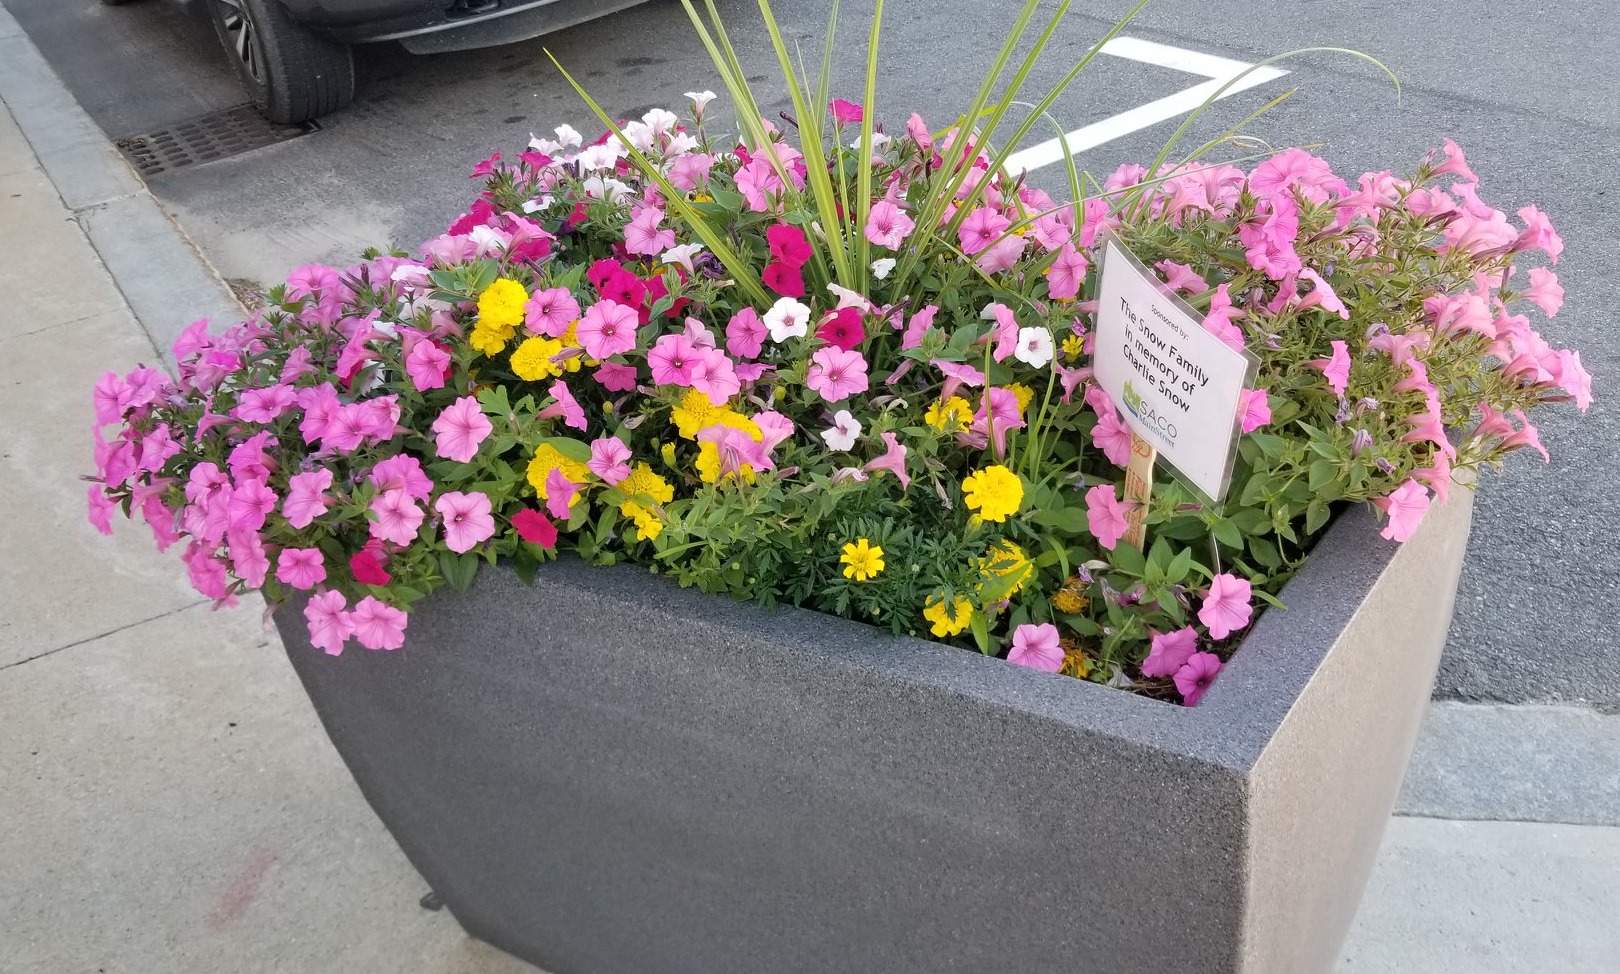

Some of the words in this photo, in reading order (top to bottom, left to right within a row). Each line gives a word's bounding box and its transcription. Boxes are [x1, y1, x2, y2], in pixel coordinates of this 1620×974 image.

[1120, 296, 1137, 324] The
[1138, 318, 1167, 352] Snow
[1168, 345, 1209, 387] Family
[1151, 304, 1179, 333] Sponsored
[1180, 328, 1189, 342] by:
[1123, 344, 1156, 386] Charlie
[1158, 380, 1190, 413] Snow
[1125, 324, 1133, 343] in
[1135, 339, 1179, 384] memory
[1181, 380, 1196, 396] of
[1139, 400, 1178, 438] SACO
